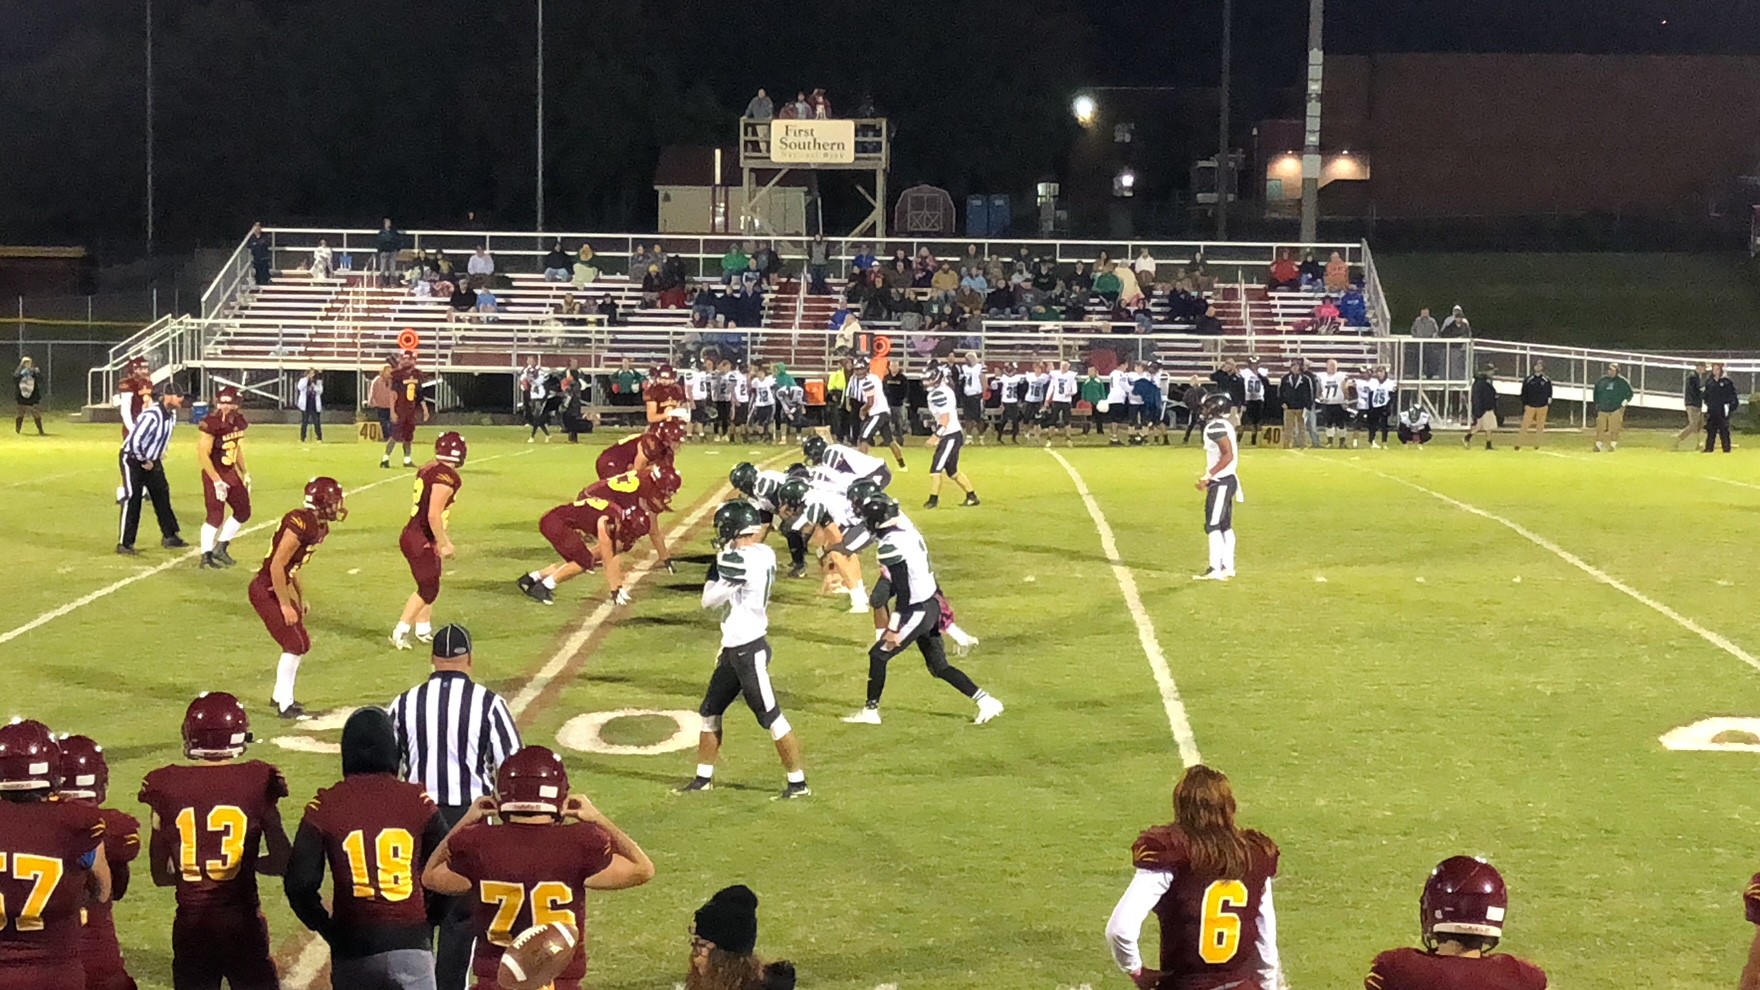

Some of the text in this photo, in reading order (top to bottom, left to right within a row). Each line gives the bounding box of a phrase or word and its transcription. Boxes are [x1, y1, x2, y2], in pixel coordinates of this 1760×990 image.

[779, 137, 846, 151] Southern
[785, 125, 815, 137] First
[359, 422, 378, 440] 40
[1263, 426, 1281, 445] 40
[175, 804, 248, 882] 13
[343, 828, 414, 902] 18
[480, 880, 577, 947] 76
[1199, 879, 1248, 964] 6
